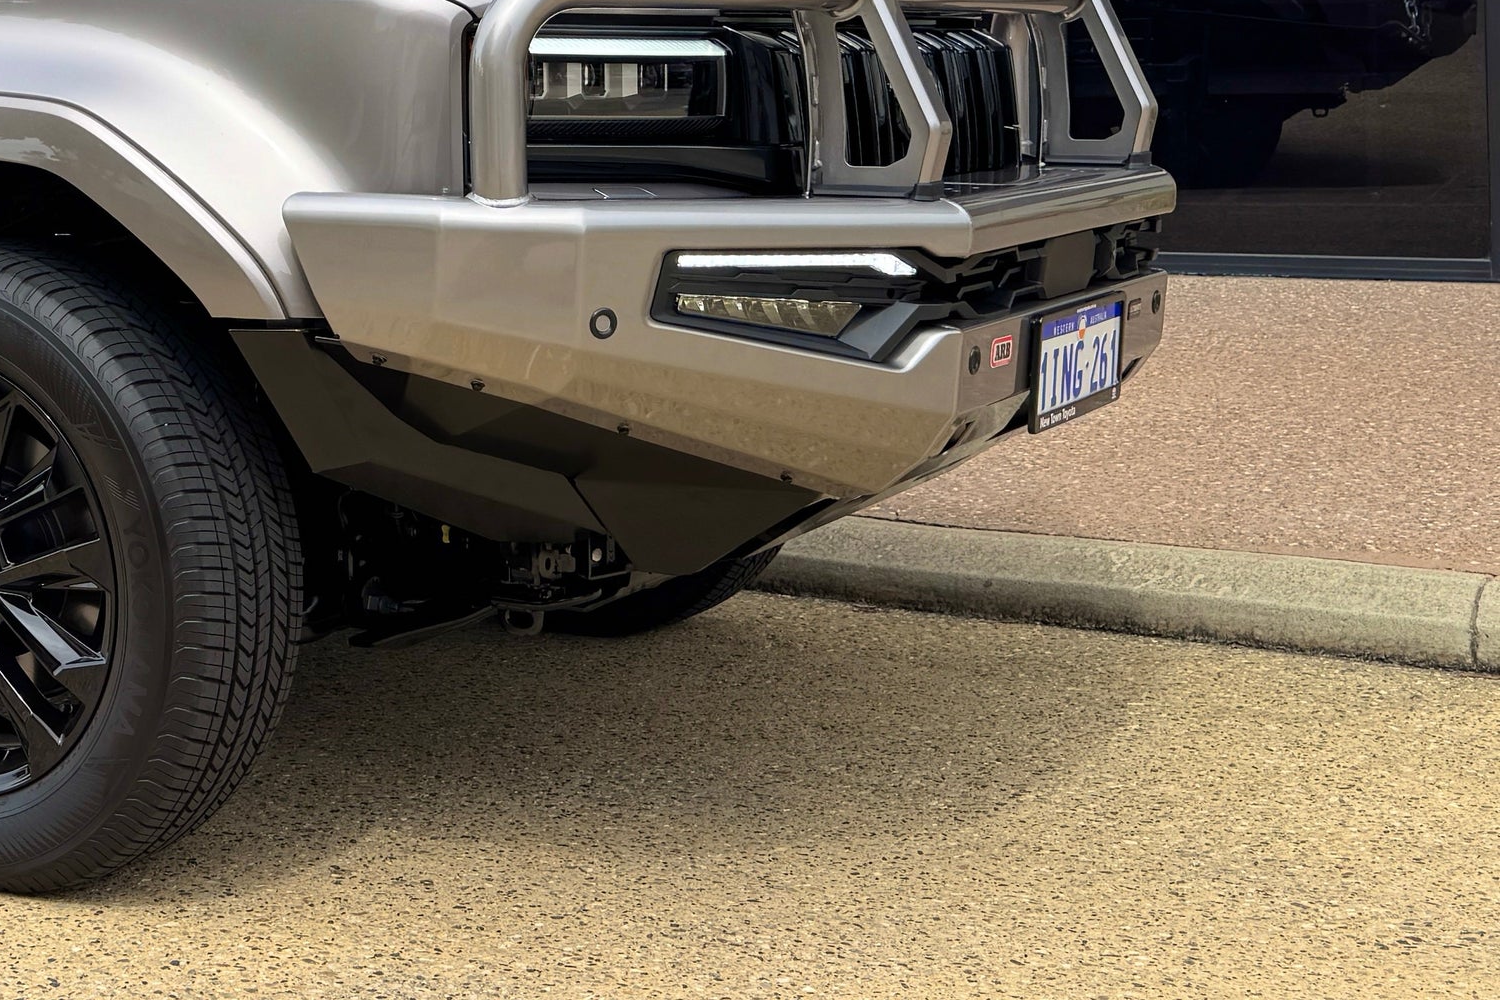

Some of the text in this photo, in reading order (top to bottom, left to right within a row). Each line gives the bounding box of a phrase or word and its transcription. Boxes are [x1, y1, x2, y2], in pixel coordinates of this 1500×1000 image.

[994, 339, 1011, 361] ARB
[1040, 405, 1076, 429] New Town Toyota
